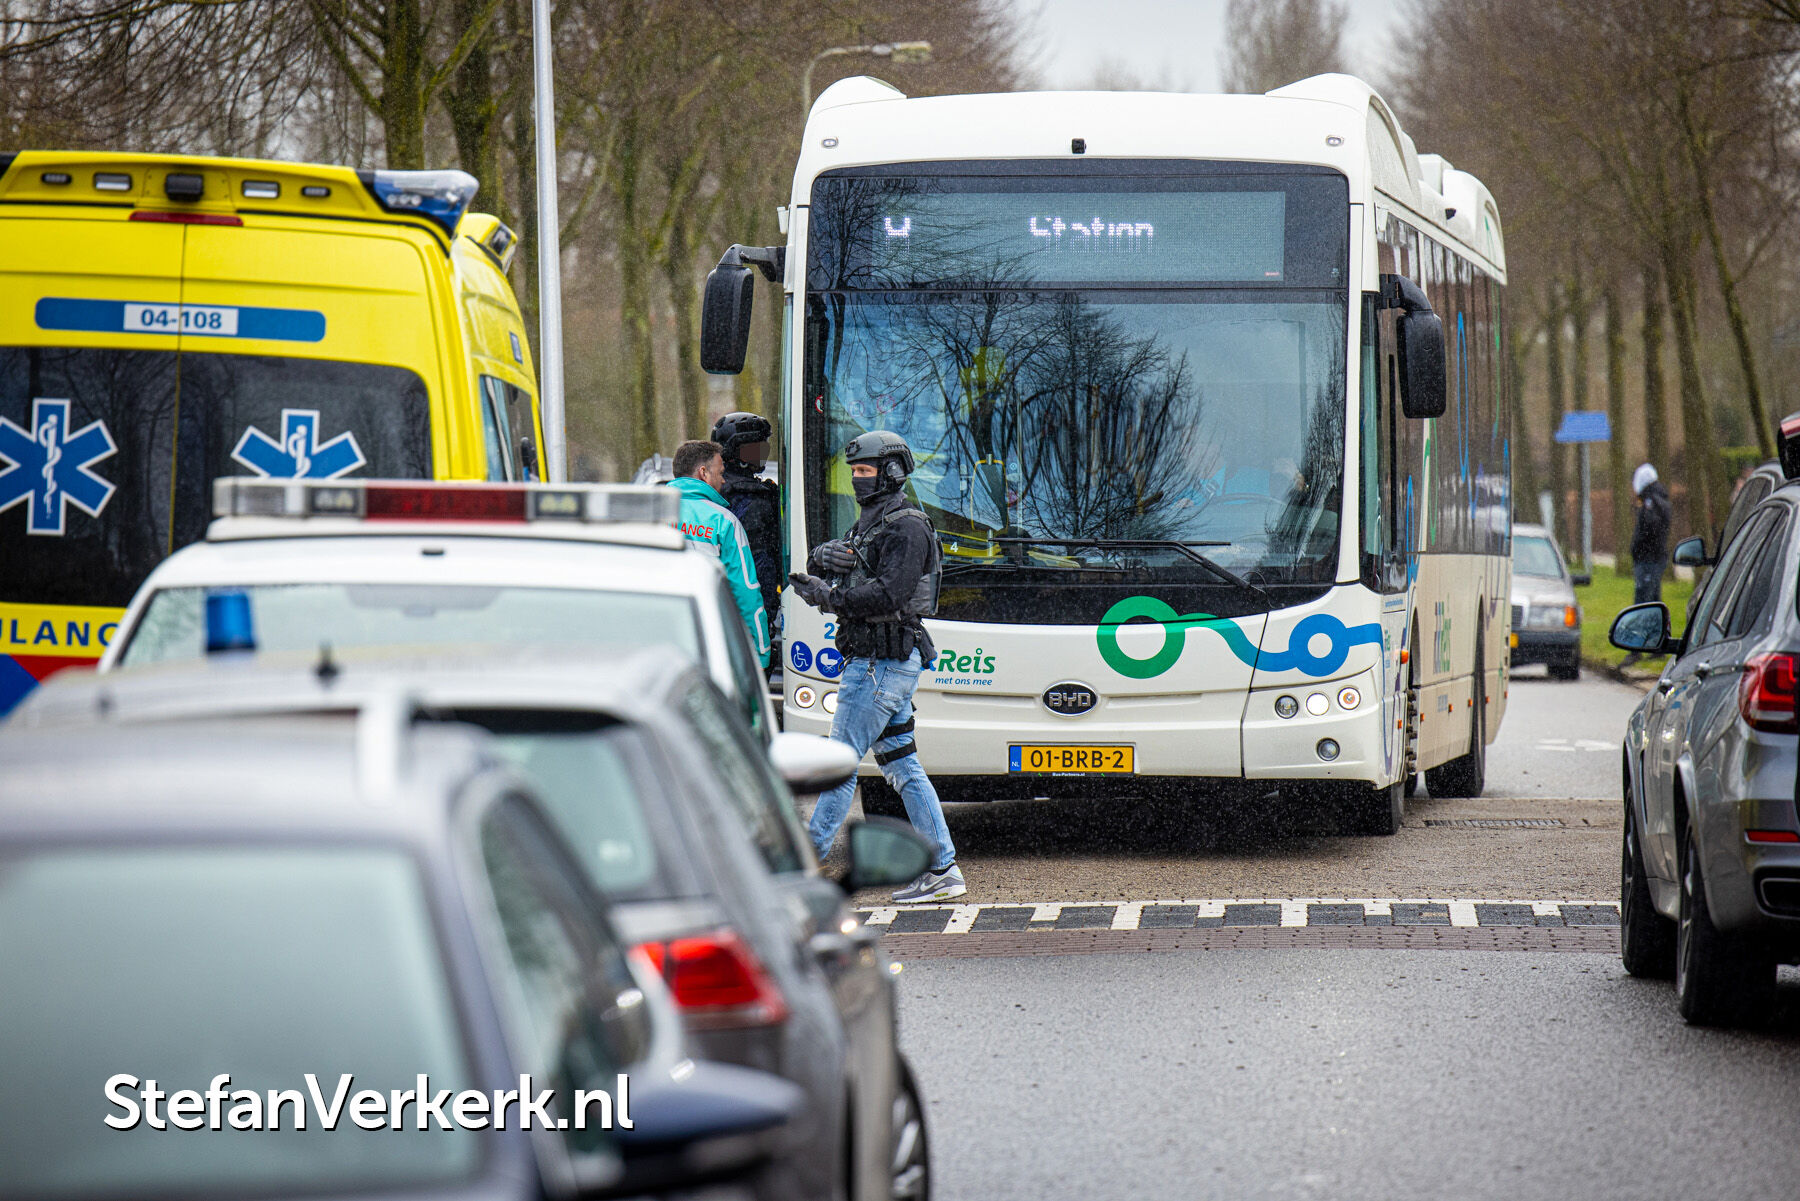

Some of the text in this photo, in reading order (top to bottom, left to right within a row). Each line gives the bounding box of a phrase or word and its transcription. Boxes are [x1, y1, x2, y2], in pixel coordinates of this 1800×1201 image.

[141, 308, 222, 330] 04-108
[950, 541, 959, 553] 4
[0, 618, 119, 647] LANC
[935, 677, 952, 685] met
[955, 678, 970, 686] ons
[1048, 692, 1091, 707] BYD
[1030, 750, 1124, 768] 01-BRB-2
